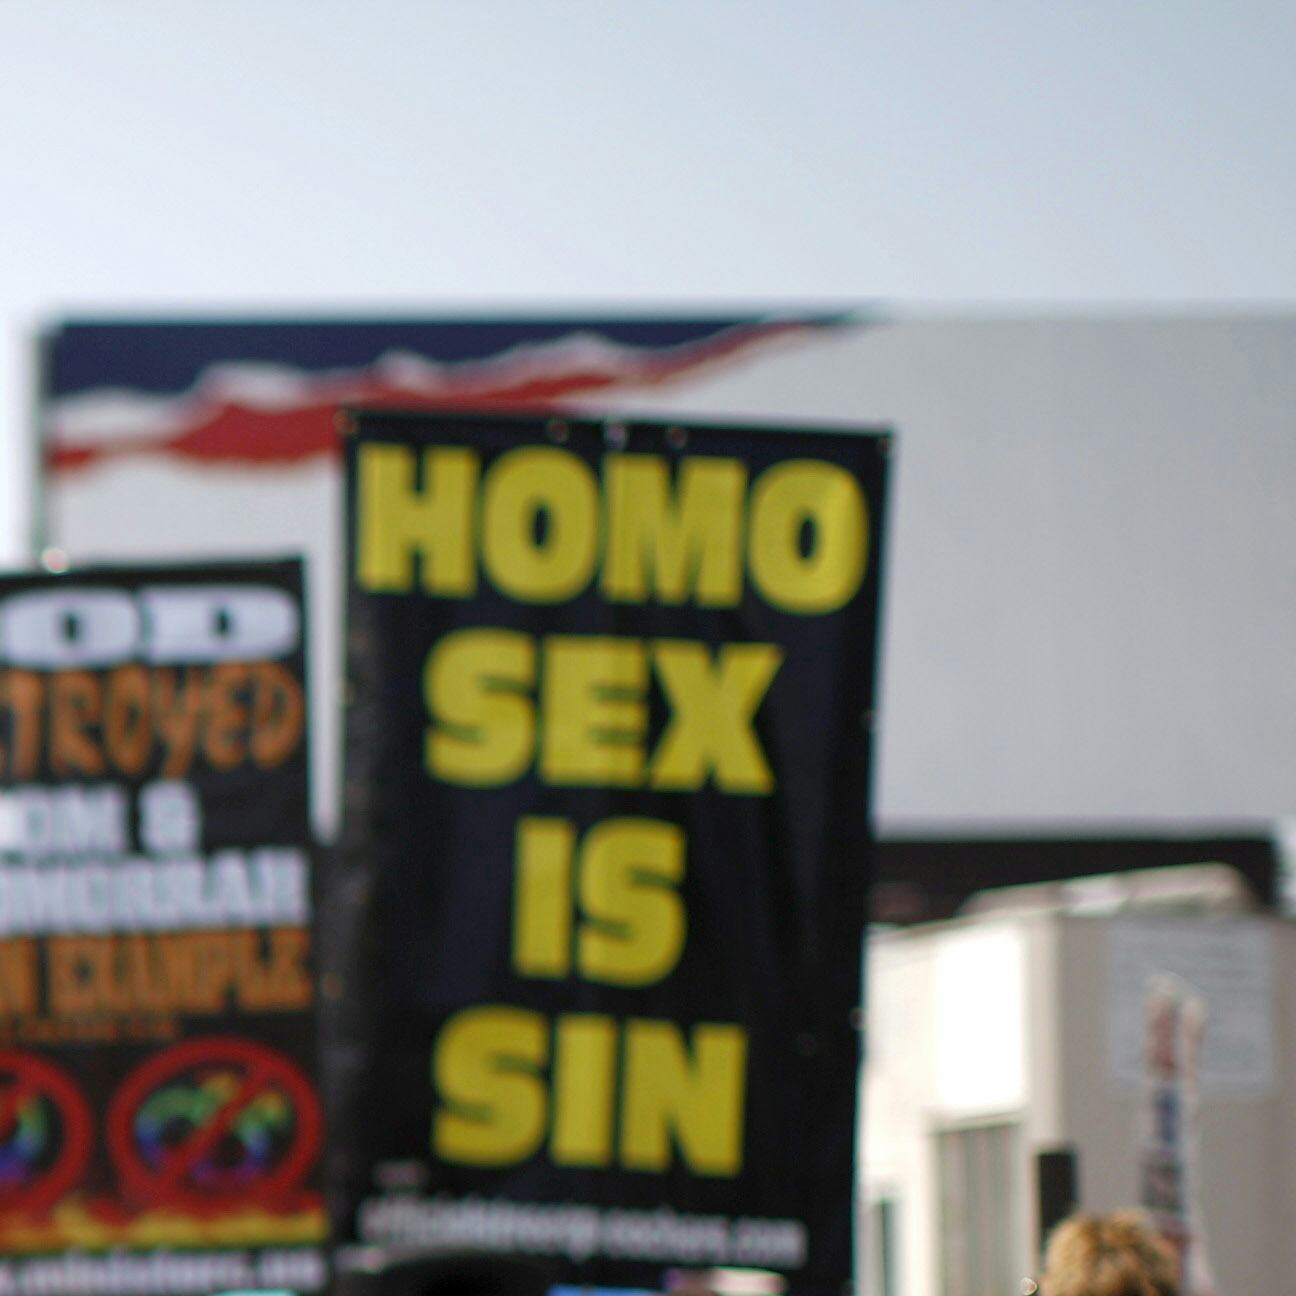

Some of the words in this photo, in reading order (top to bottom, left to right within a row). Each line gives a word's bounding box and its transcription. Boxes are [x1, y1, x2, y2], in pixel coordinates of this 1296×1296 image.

[356, 443, 869, 616] HOMO
[423, 626, 784, 796] SEX
[512, 815, 688, 987] IS
[432, 1005, 747, 1177] SIN
